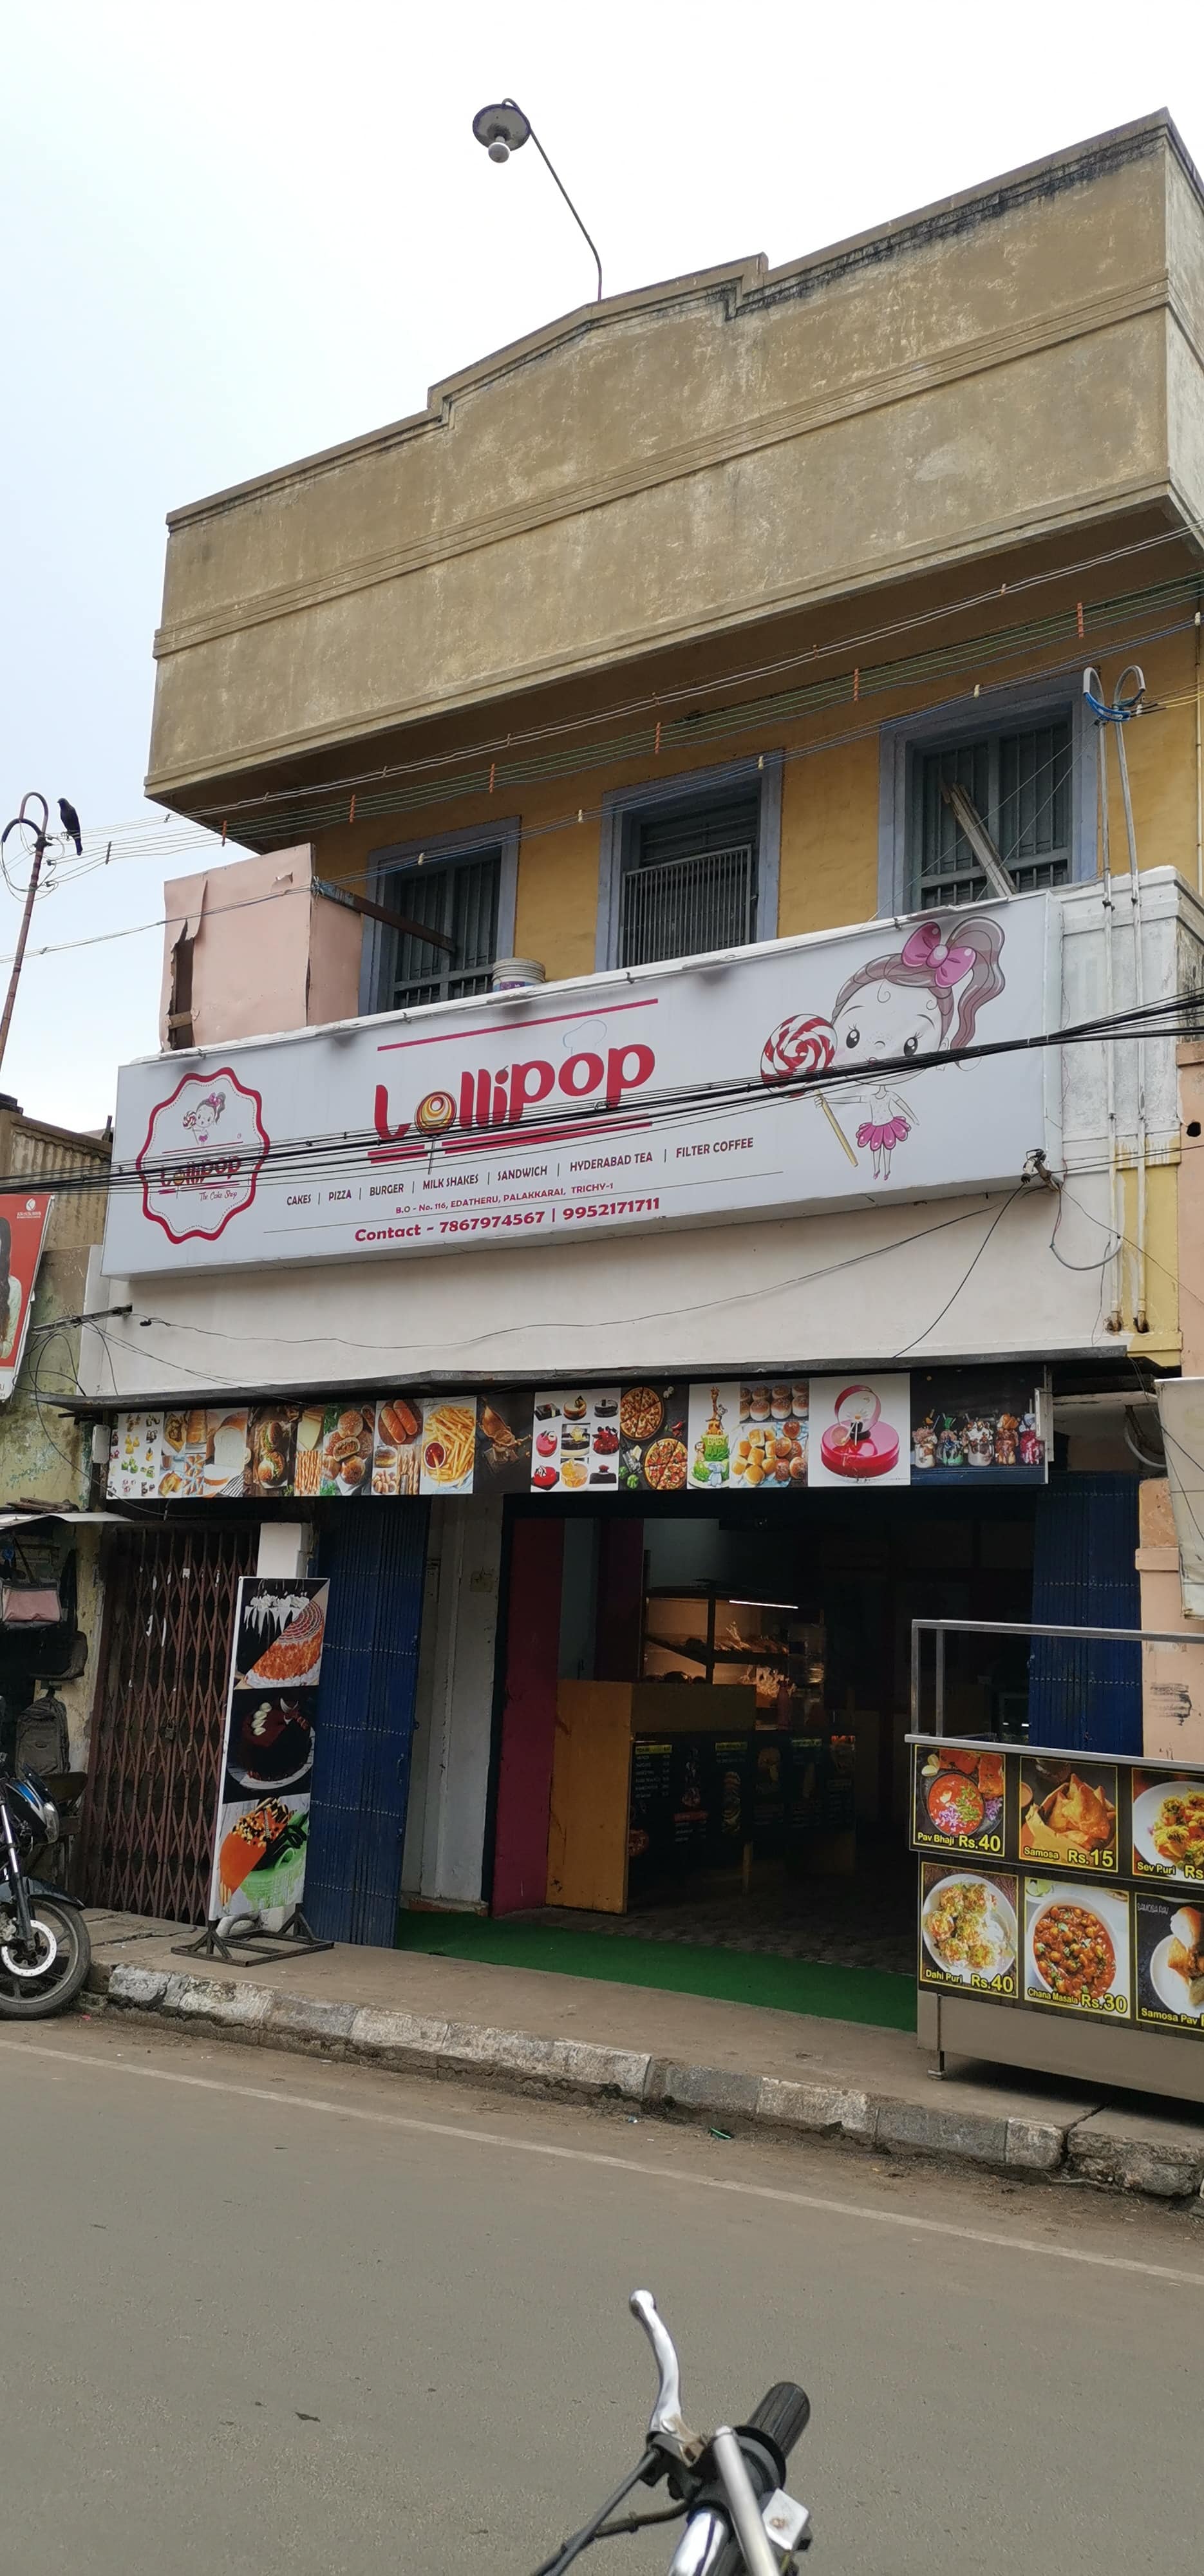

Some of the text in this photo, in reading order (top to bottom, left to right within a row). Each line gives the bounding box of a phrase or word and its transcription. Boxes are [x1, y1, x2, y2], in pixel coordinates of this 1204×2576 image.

[374, 1044, 655, 1140] Lollipop
[287, 1194, 312, 1206] CAKES
[328, 1189, 352, 1201] PIZZA
[370, 1183, 404, 1197] BURGER
[422, 1178, 444, 1190] MILK
[446, 1174, 479, 1188] SHAKES
[497, 1165, 547, 1181] SANDWICH
[570, 1155, 632, 1172] HYDERABAD
[634, 1151, 653, 1163] TEA
[676, 1144, 710, 1159] FILTER
[713, 1137, 754, 1153] COFFEE
[451, 1195, 501, 1208] EDATHERU,
[503, 1188, 566, 1202] PALAKKARAI,
[571, 1182, 614, 1194] TRICHY-1
[355, 1224, 421, 1242] Contact
[439, 1210, 545, 1233] 7867974567
[563, 1197, 660, 1220] 9952171711
[917, 1832, 955, 1846] Pav Bhaji
[958, 1834, 1001, 1852] Rs.40
[1024, 1846, 1060, 1860] Samosa
[1137, 1861, 1155, 1873] Sev
[946, 1973, 963, 1984] Puri
[971, 1974, 1014, 1993] Rs.40
[1028, 1988, 1078, 2005] Chana Masala
[1081, 1994, 1127, 2013] Rs.30
[1141, 2007, 1178, 2022] Samosa
[1180, 2014, 1198, 2025] Pav
